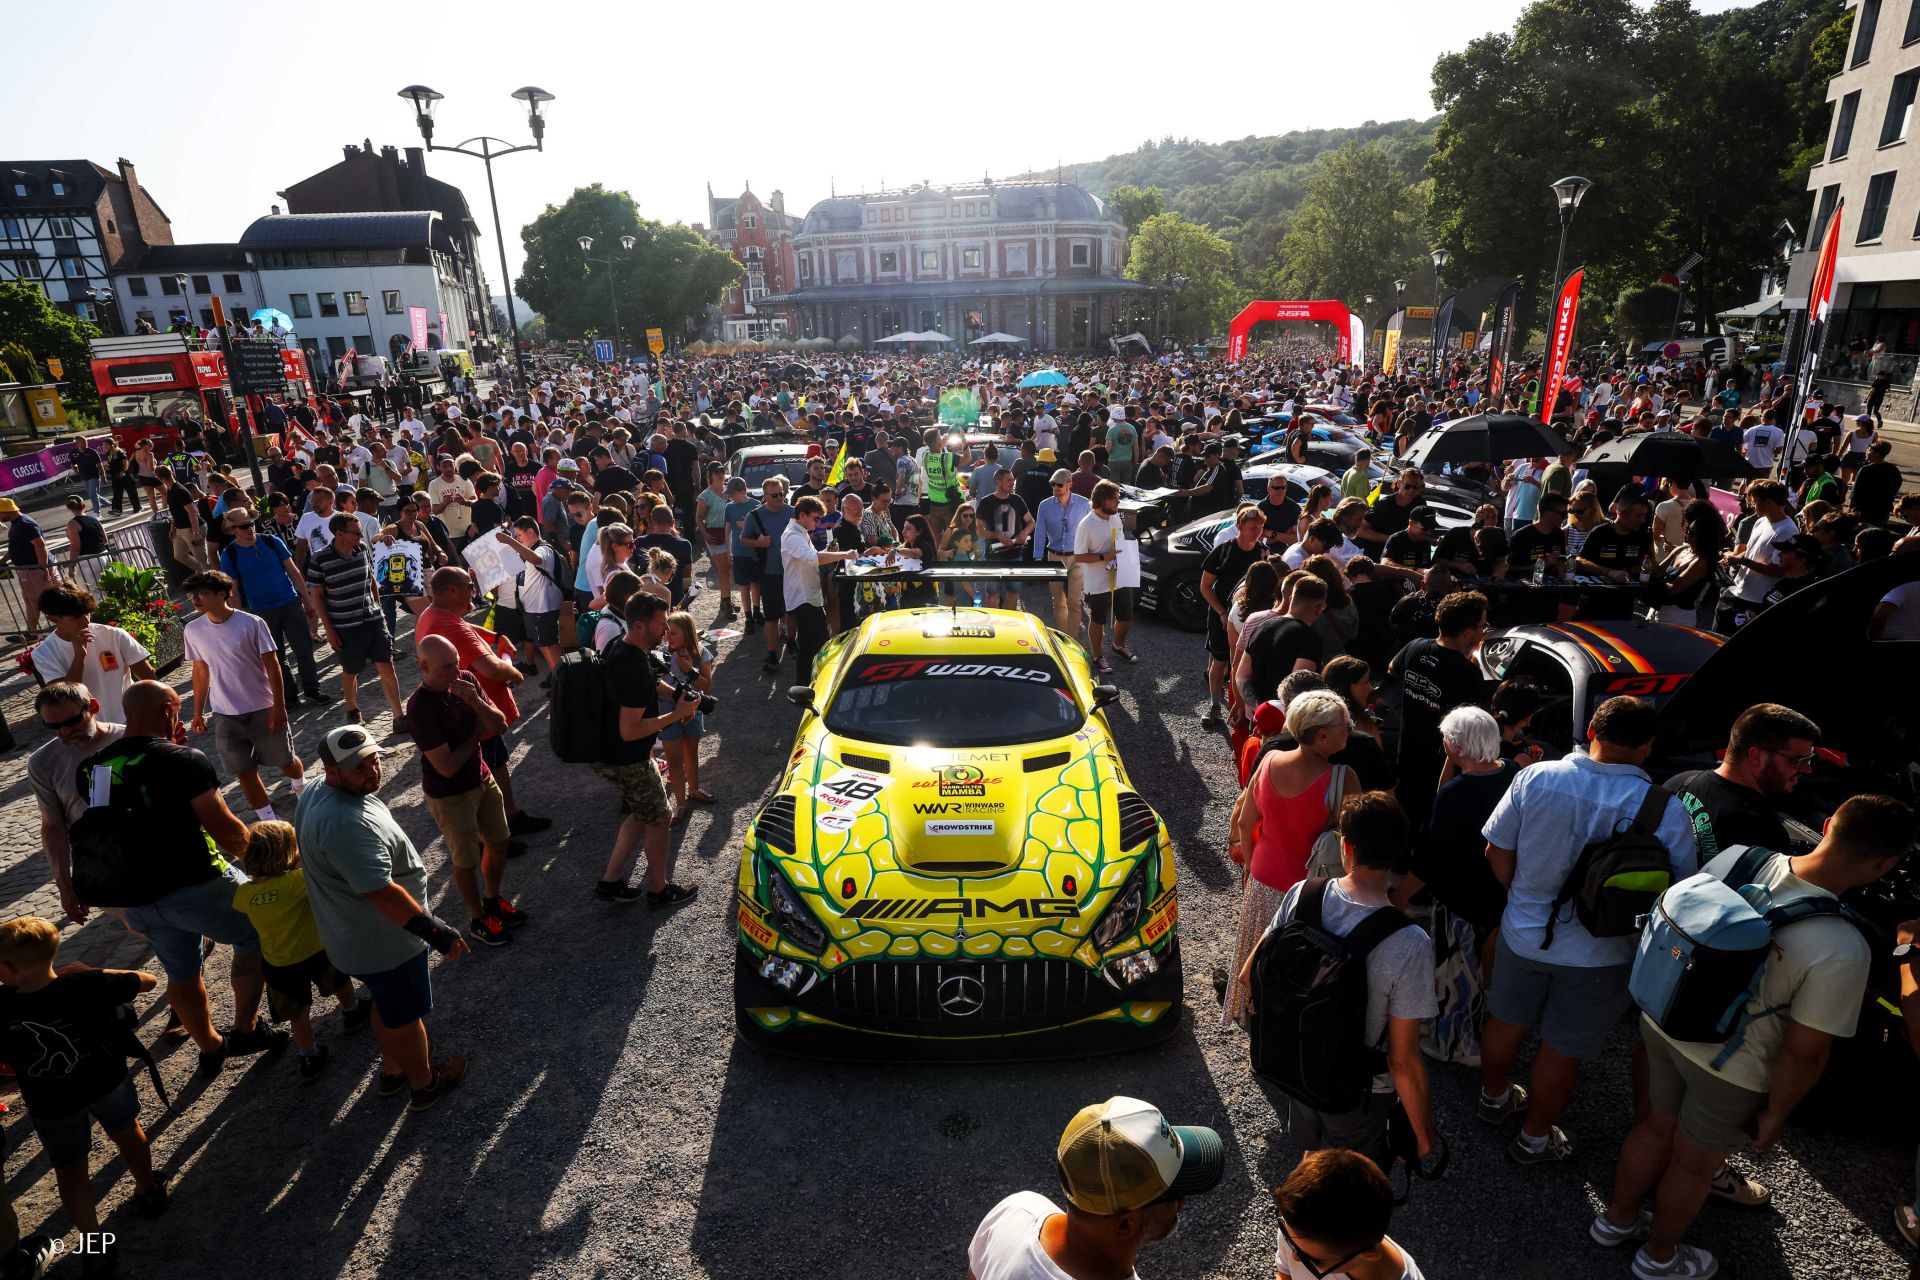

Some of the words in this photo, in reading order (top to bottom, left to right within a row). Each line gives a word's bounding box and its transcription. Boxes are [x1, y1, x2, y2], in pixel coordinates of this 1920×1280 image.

[819, 792, 853, 807] ROWE
[822, 779, 884, 800] 48
[928, 823, 994, 834] CROWDSTRIKE
[249, 889, 280, 905] 46
[914, 898, 1081, 918] AMG
[741, 912, 773, 943] PIRELLI
[1146, 904, 1176, 940] PIRELLI
